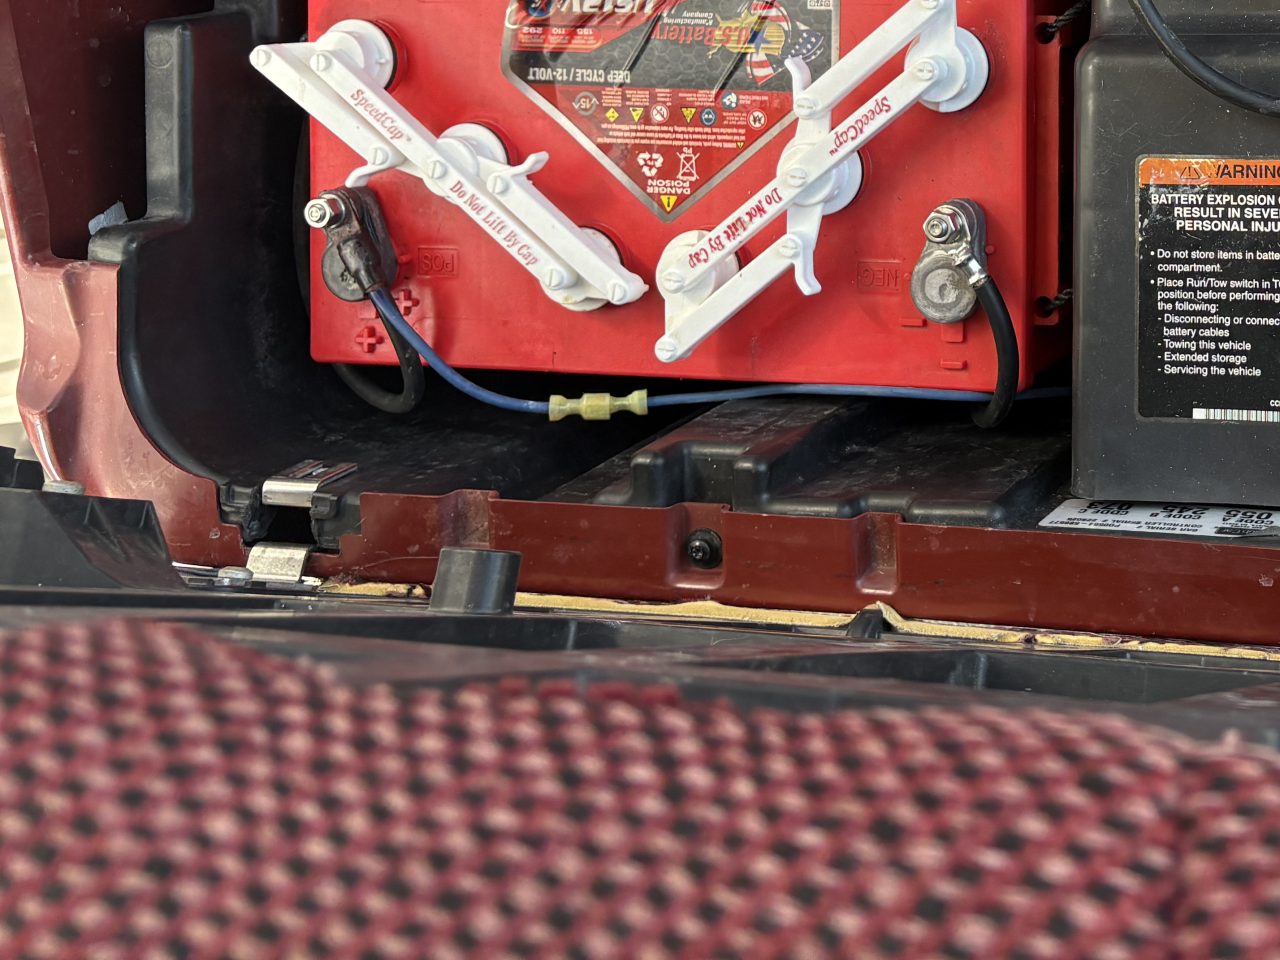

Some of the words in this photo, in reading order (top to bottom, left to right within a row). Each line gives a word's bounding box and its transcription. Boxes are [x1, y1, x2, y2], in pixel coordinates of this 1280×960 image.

[527, 66, 568, 81] 12-VOLT
[575, 68, 605, 82] CYCLE
[607, 69, 631, 83] DEEP
[648, 179, 690, 187] POISON
[646, 185, 691, 195] DANGER
[1151, 194, 1203, 205] BATTERY
[1207, 194, 1275, 206] EXPLOSION
[1174, 207, 1224, 218] RESULT
[1228, 208, 1240, 218] IN
[1176, 220, 1247, 231] PERSONAL
[1157, 249, 1171, 259] Do
[1174, 250, 1188, 259] not
[1191, 251, 1214, 259] store
[1217, 250, 1243, 260] items
[1245, 251, 1254, 260] in
[1158, 264, 1223, 274] compartment.
[1157, 278, 1183, 287] Place
[1186, 279, 1227, 288] Run/Tow
[1230, 279, 1259, 288] switch
[1262, 280, 1270, 288] in
[1158, 290, 1194, 301] position
[1197, 291, 1226, 300] before
[1229, 291, 1280, 303] performing
[1158, 302, 1172, 310] the
[1175, 301, 1219, 313] following:
[1164, 314, 1230, 326] Disconnecting
[1163, 327, 1196, 338] battery
[1199, 328, 1229, 336] cables
[1163, 340, 1196, 350] Towing
[1199, 340, 1215, 349] this
[1218, 341, 1251, 350] vehicle
[1164, 352, 1209, 362] Extended
[1212, 354, 1247, 365] storage
[1164, 365, 1208, 376] Servicing
[1211, 366, 1225, 375] the
[1228, 367, 1261, 376] vehicle
[1086, 502, 1134, 510] 073
[1160, 505, 1209, 514] 245
[1225, 509, 1272, 520] 055
